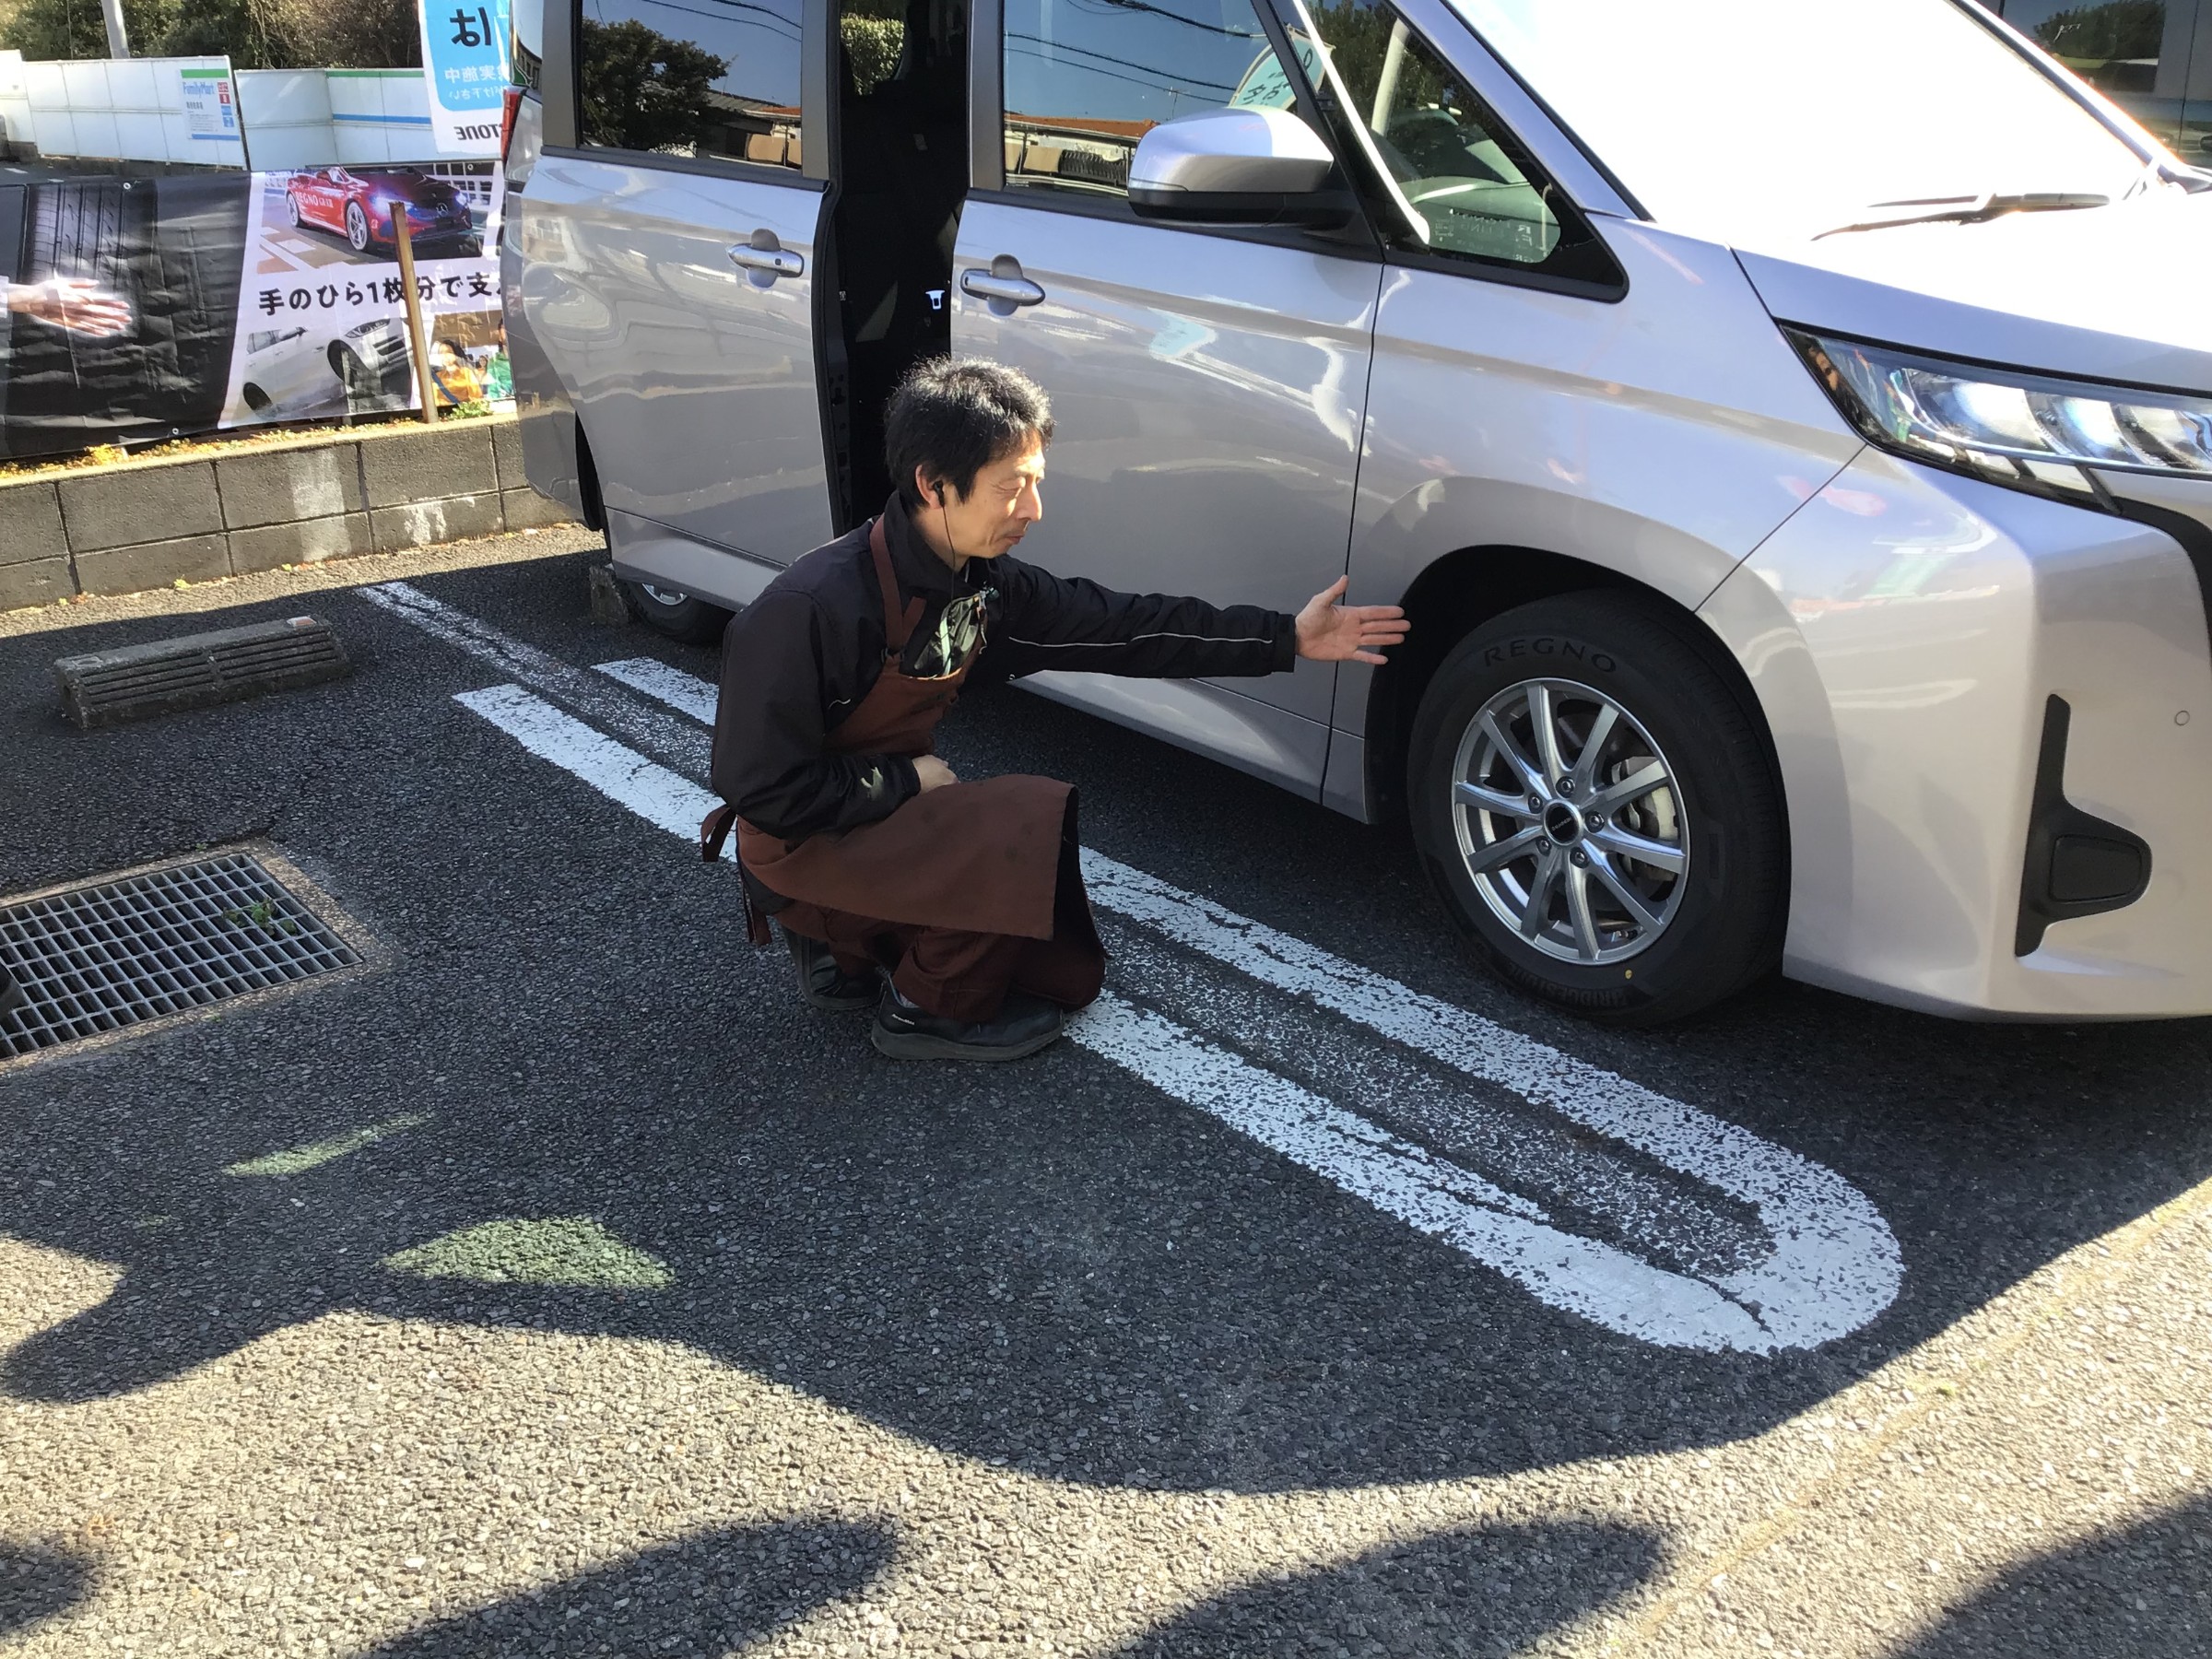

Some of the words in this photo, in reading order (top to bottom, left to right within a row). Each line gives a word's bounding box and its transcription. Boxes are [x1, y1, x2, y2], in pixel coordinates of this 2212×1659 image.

[259, 272, 501, 316] 手のひら1枚分で支
[1484, 638, 1617, 672] REGNO
